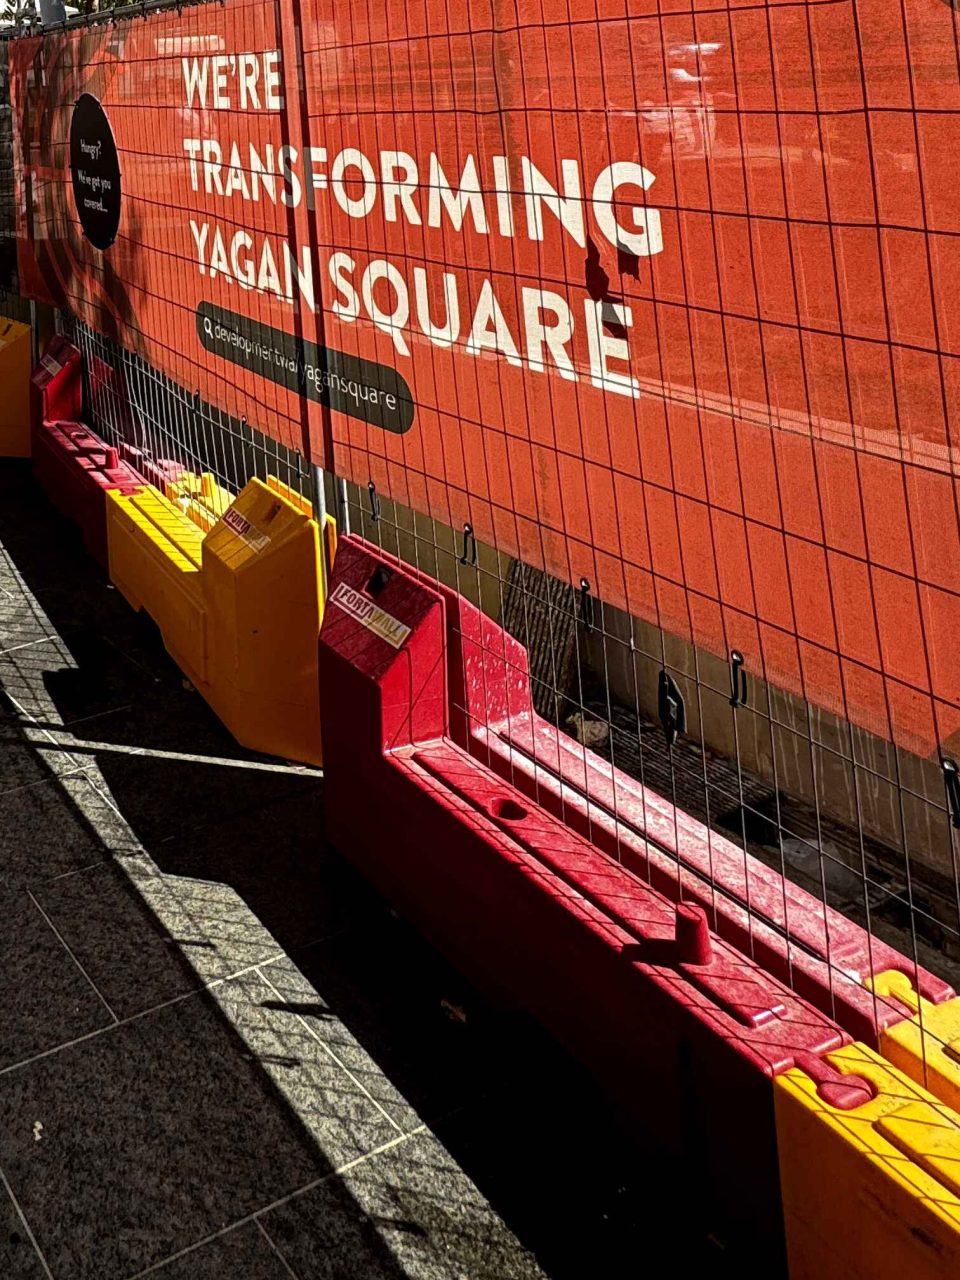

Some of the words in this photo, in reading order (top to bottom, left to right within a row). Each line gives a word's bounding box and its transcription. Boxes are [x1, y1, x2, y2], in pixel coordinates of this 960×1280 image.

[182, 49, 284, 110] WE'RE
[79, 138, 102, 160] Hungry?
[77, 169, 91, 186] We've
[92, 176, 100, 192] got
[101, 178, 112, 193] you
[183, 138, 664, 257] TRANSFORMING
[189, 219, 315, 314] YAGAN
[328, 251, 641, 400] SQUARE
